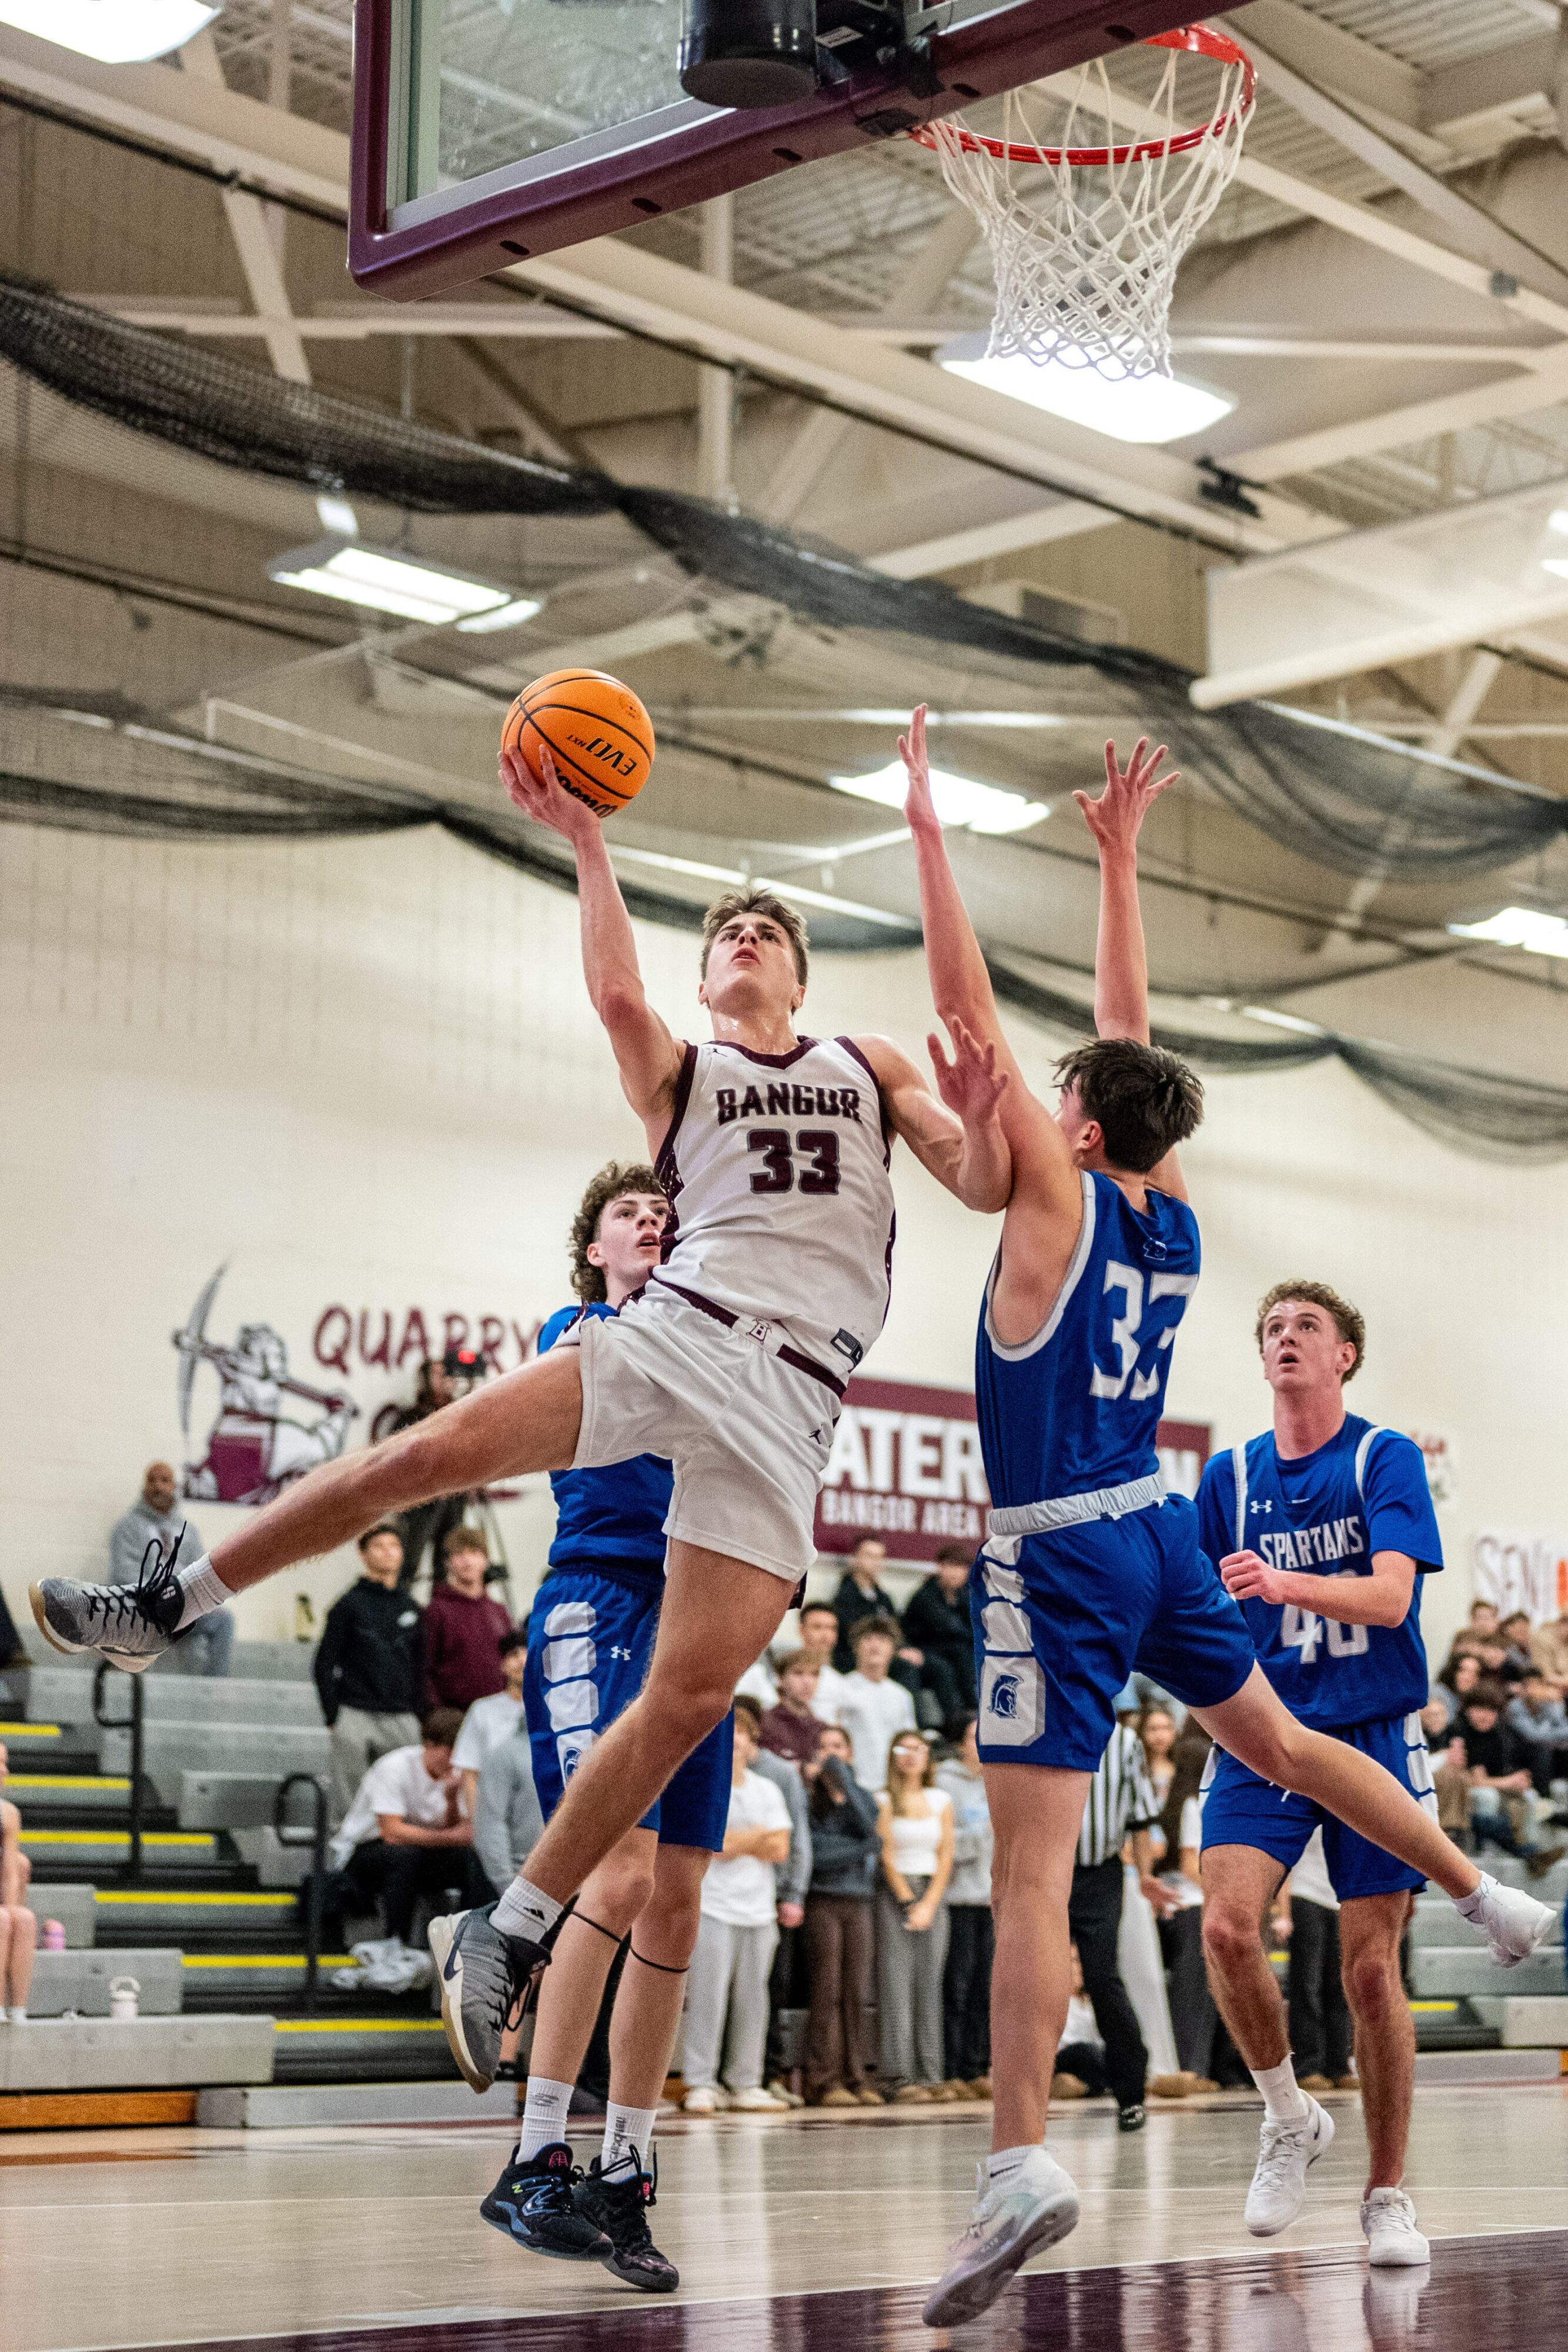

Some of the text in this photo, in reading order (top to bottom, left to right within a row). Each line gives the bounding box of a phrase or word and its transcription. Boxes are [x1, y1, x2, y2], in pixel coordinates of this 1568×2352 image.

[586, 737, 637, 776] EVO
[716, 1082, 862, 1125] BANGOR
[747, 1128, 841, 1195] 33
[313, 1305, 541, 1376] QUARRY
[822, 1488, 915, 1534] BANGOR
[922, 1502, 979, 1539] AREA
[1259, 1515, 1365, 1570] SPARTANS
